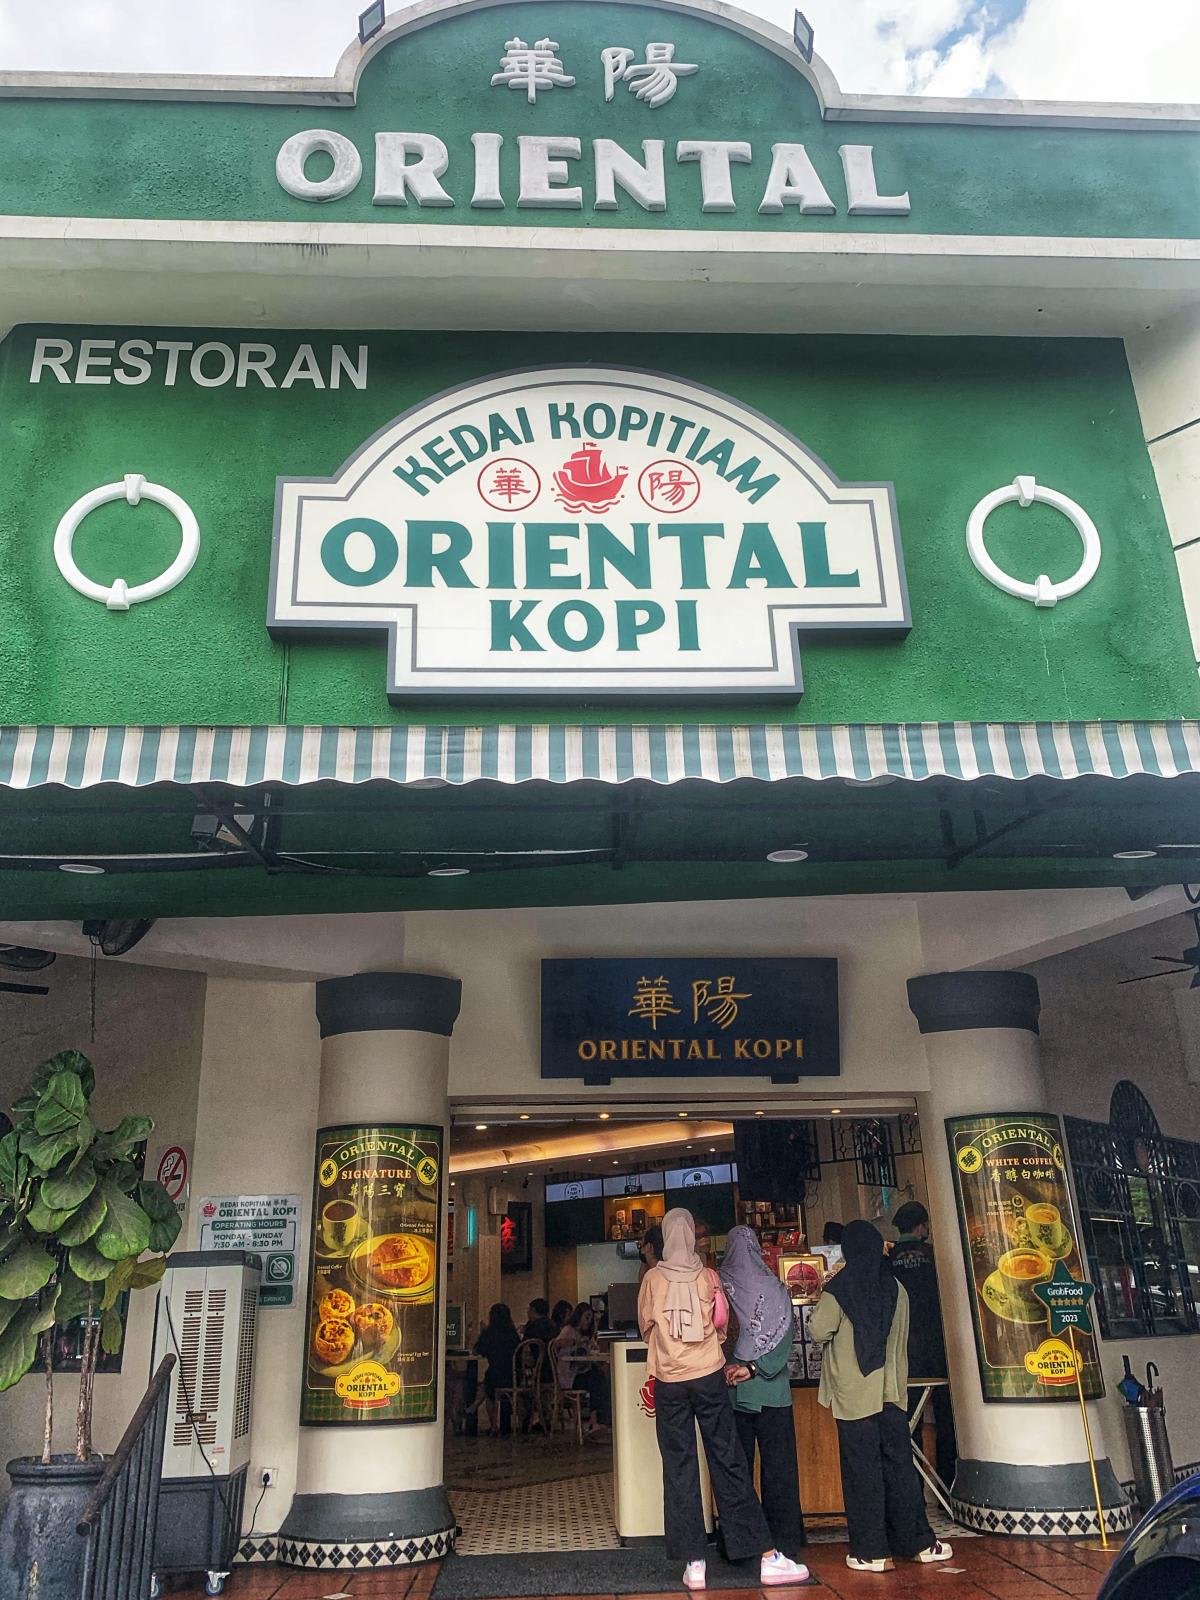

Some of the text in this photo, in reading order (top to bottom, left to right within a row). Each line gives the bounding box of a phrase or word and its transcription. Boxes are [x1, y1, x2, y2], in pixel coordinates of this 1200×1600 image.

[275, 128, 911, 216] ORIENTAL
[29, 338, 369, 390] RESTORAN
[392, 401, 781, 505] KEDAI KOPITIAM
[488, 466, 532, 504] 華
[320, 517, 861, 591] ORIENTAL
[489, 600, 702, 653] KOPI
[577, 1038, 805, 1061] ORIENTAL KOPI
[982, 1128, 1050, 1148] ORIENTAL
[340, 1140, 415, 1161] ORIENTAL
[986, 1157, 1020, 1167] WHITE
[341, 1169, 412, 1179] SIGNATURE
[218, 1207, 297, 1217] ORIENTAL KOPI
[214, 1220, 284, 1229] OPERATING HOURS
[213, 1233, 246, 1241] MONDAY
[252, 1232, 284, 1240] SUNDAY
[1047, 1286, 1083, 1296] GrabFood
[1061, 1314, 1078, 1323] 2023
[1037, 1360, 1076, 1369] ORIENTAL
[346, 1384, 389, 1392] ORIENTAL
